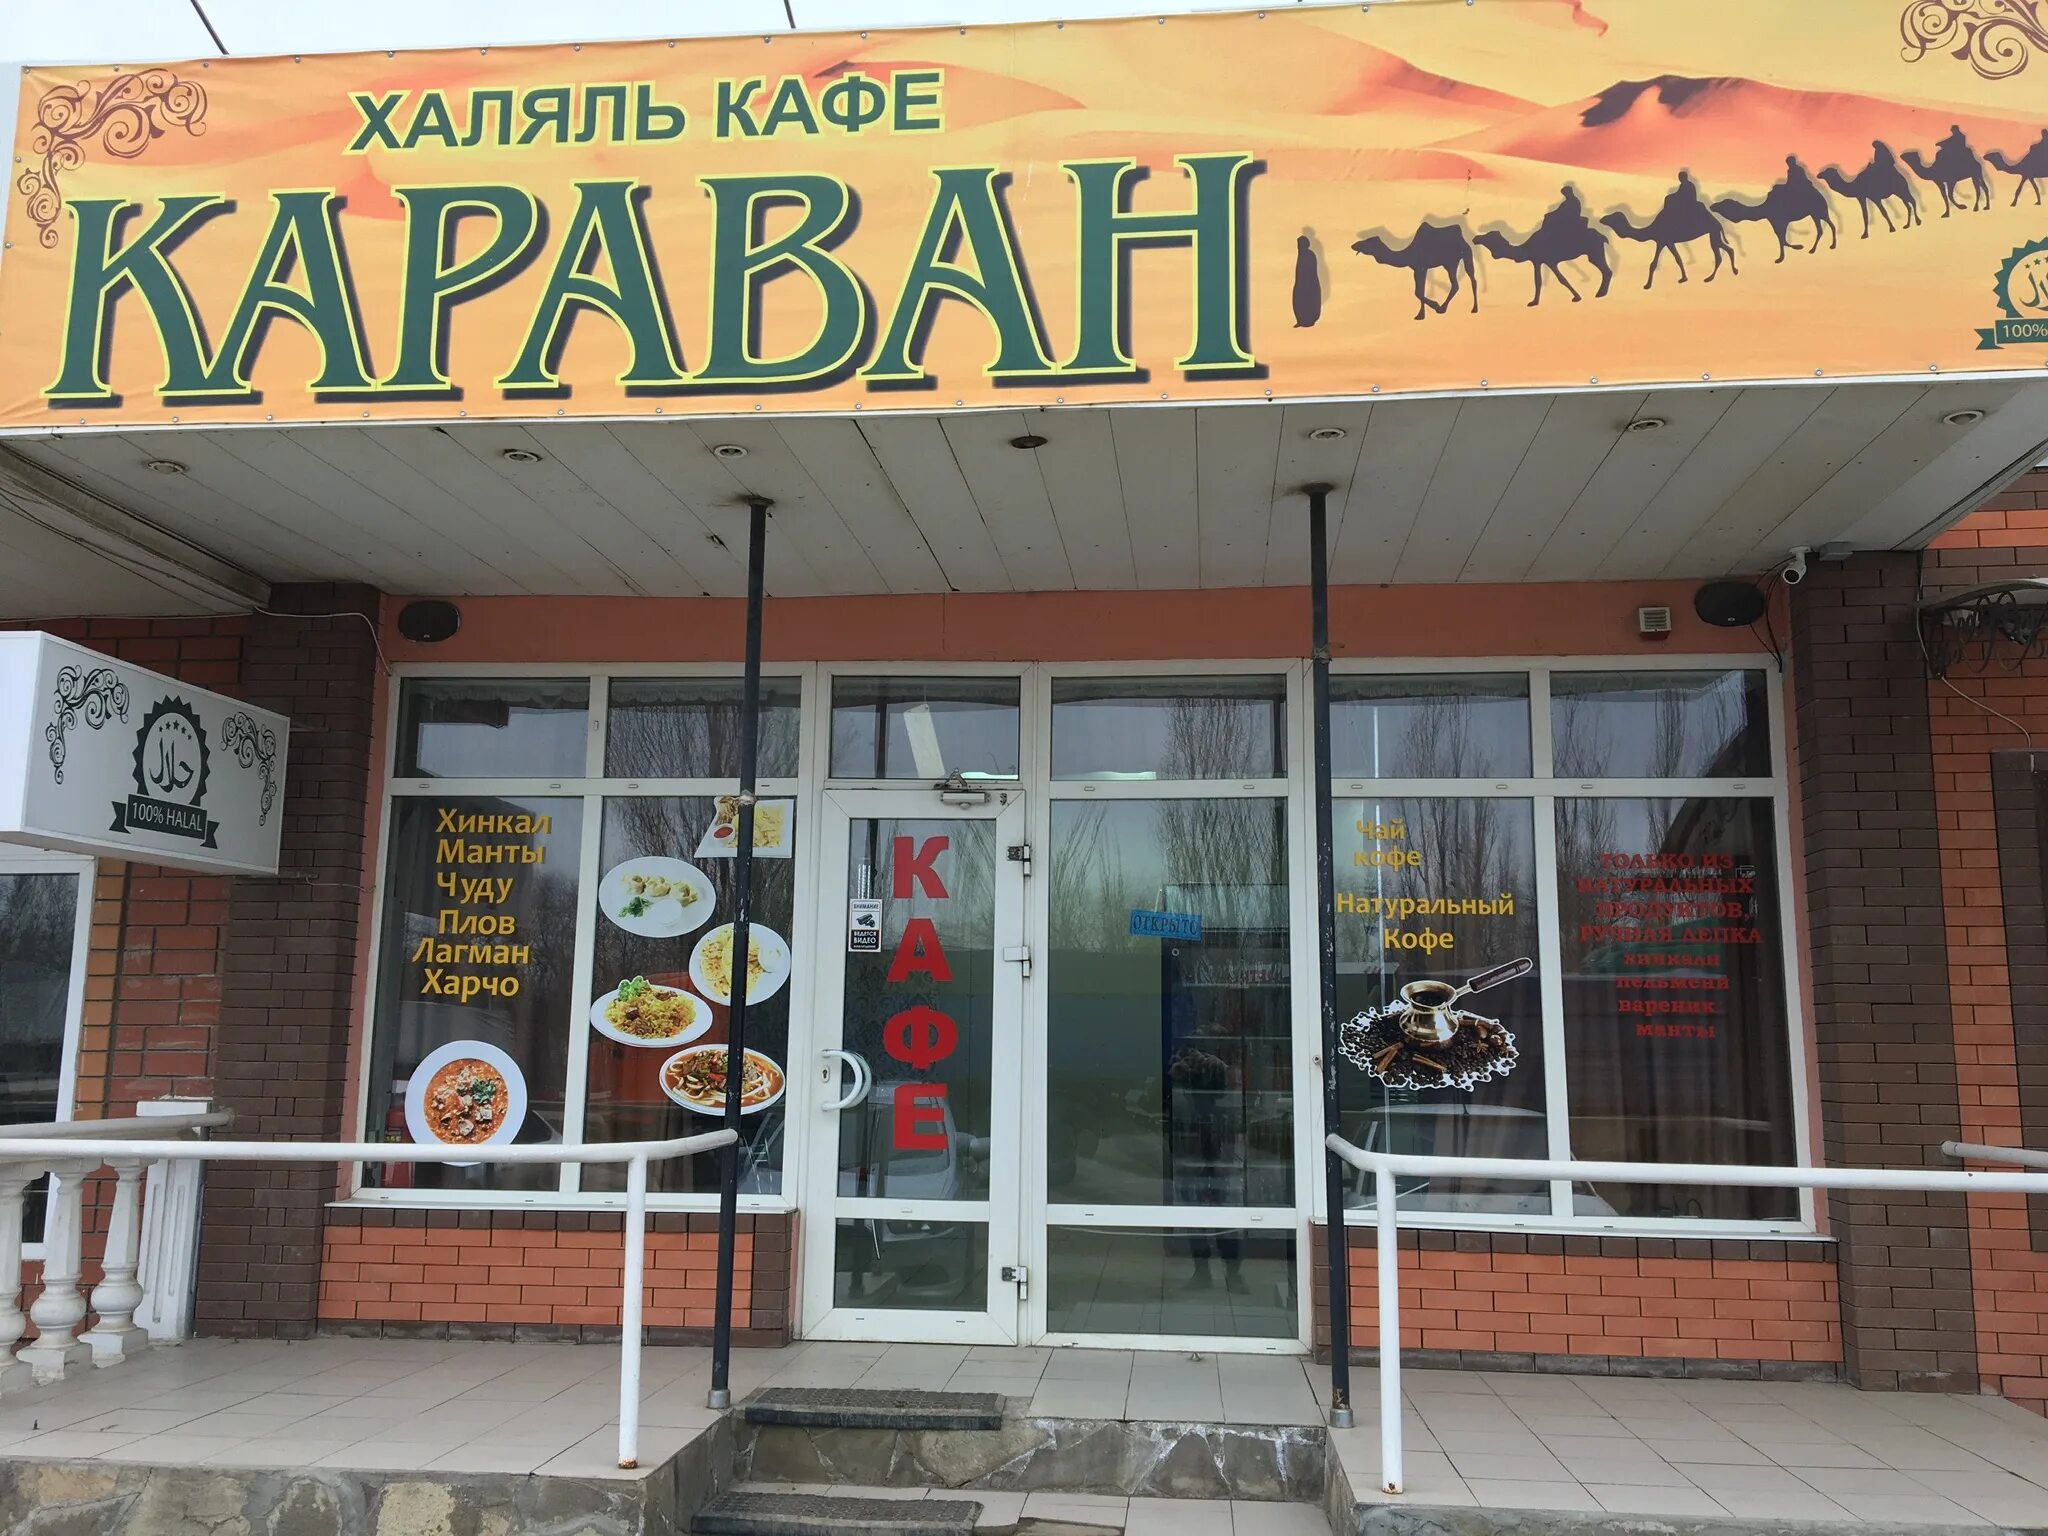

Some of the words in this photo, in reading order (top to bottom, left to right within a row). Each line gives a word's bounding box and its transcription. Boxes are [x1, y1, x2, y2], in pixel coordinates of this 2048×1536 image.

[346, 82, 688, 152] ХАЛЯЛЬ
[713, 68, 944, 140] КАФЕ
[40, 151, 1262, 402] КАРАВАН
[2002, 323, 2048, 338] 100%
[131, 801, 164, 825] 100%
[166, 806, 203, 833] HALAL
[436, 808, 552, 834] Хинкал
[1355, 817, 1407, 841] Чай
[436, 838, 544, 864] Манты
[1353, 846, 1423, 872] кофе
[1600, 852, 1694, 869] ТОЛЬКО
[1702, 853, 1735, 869] ИЗ
[436, 871, 514, 904] Чуду
[1576, 878, 1755, 893] НАТУРАЛЬНЫХ
[1336, 891, 1515, 920] Натуральный
[1595, 902, 1750, 921] ПРОДУКТОВ,
[438, 909, 516, 935] Плов
[1579, 925, 1673, 944] РУЧНАЯ
[1682, 928, 1765, 944] ЛЕПКА
[411, 937, 530, 965] Лагман
[1384, 927, 1455, 955] Кофе
[420, 968, 521, 1003] Харчо
[882, 836, 959, 1150] КАФЕ
[1615, 976, 1729, 990] пельмени
[1635, 1023, 1717, 1039] манты
